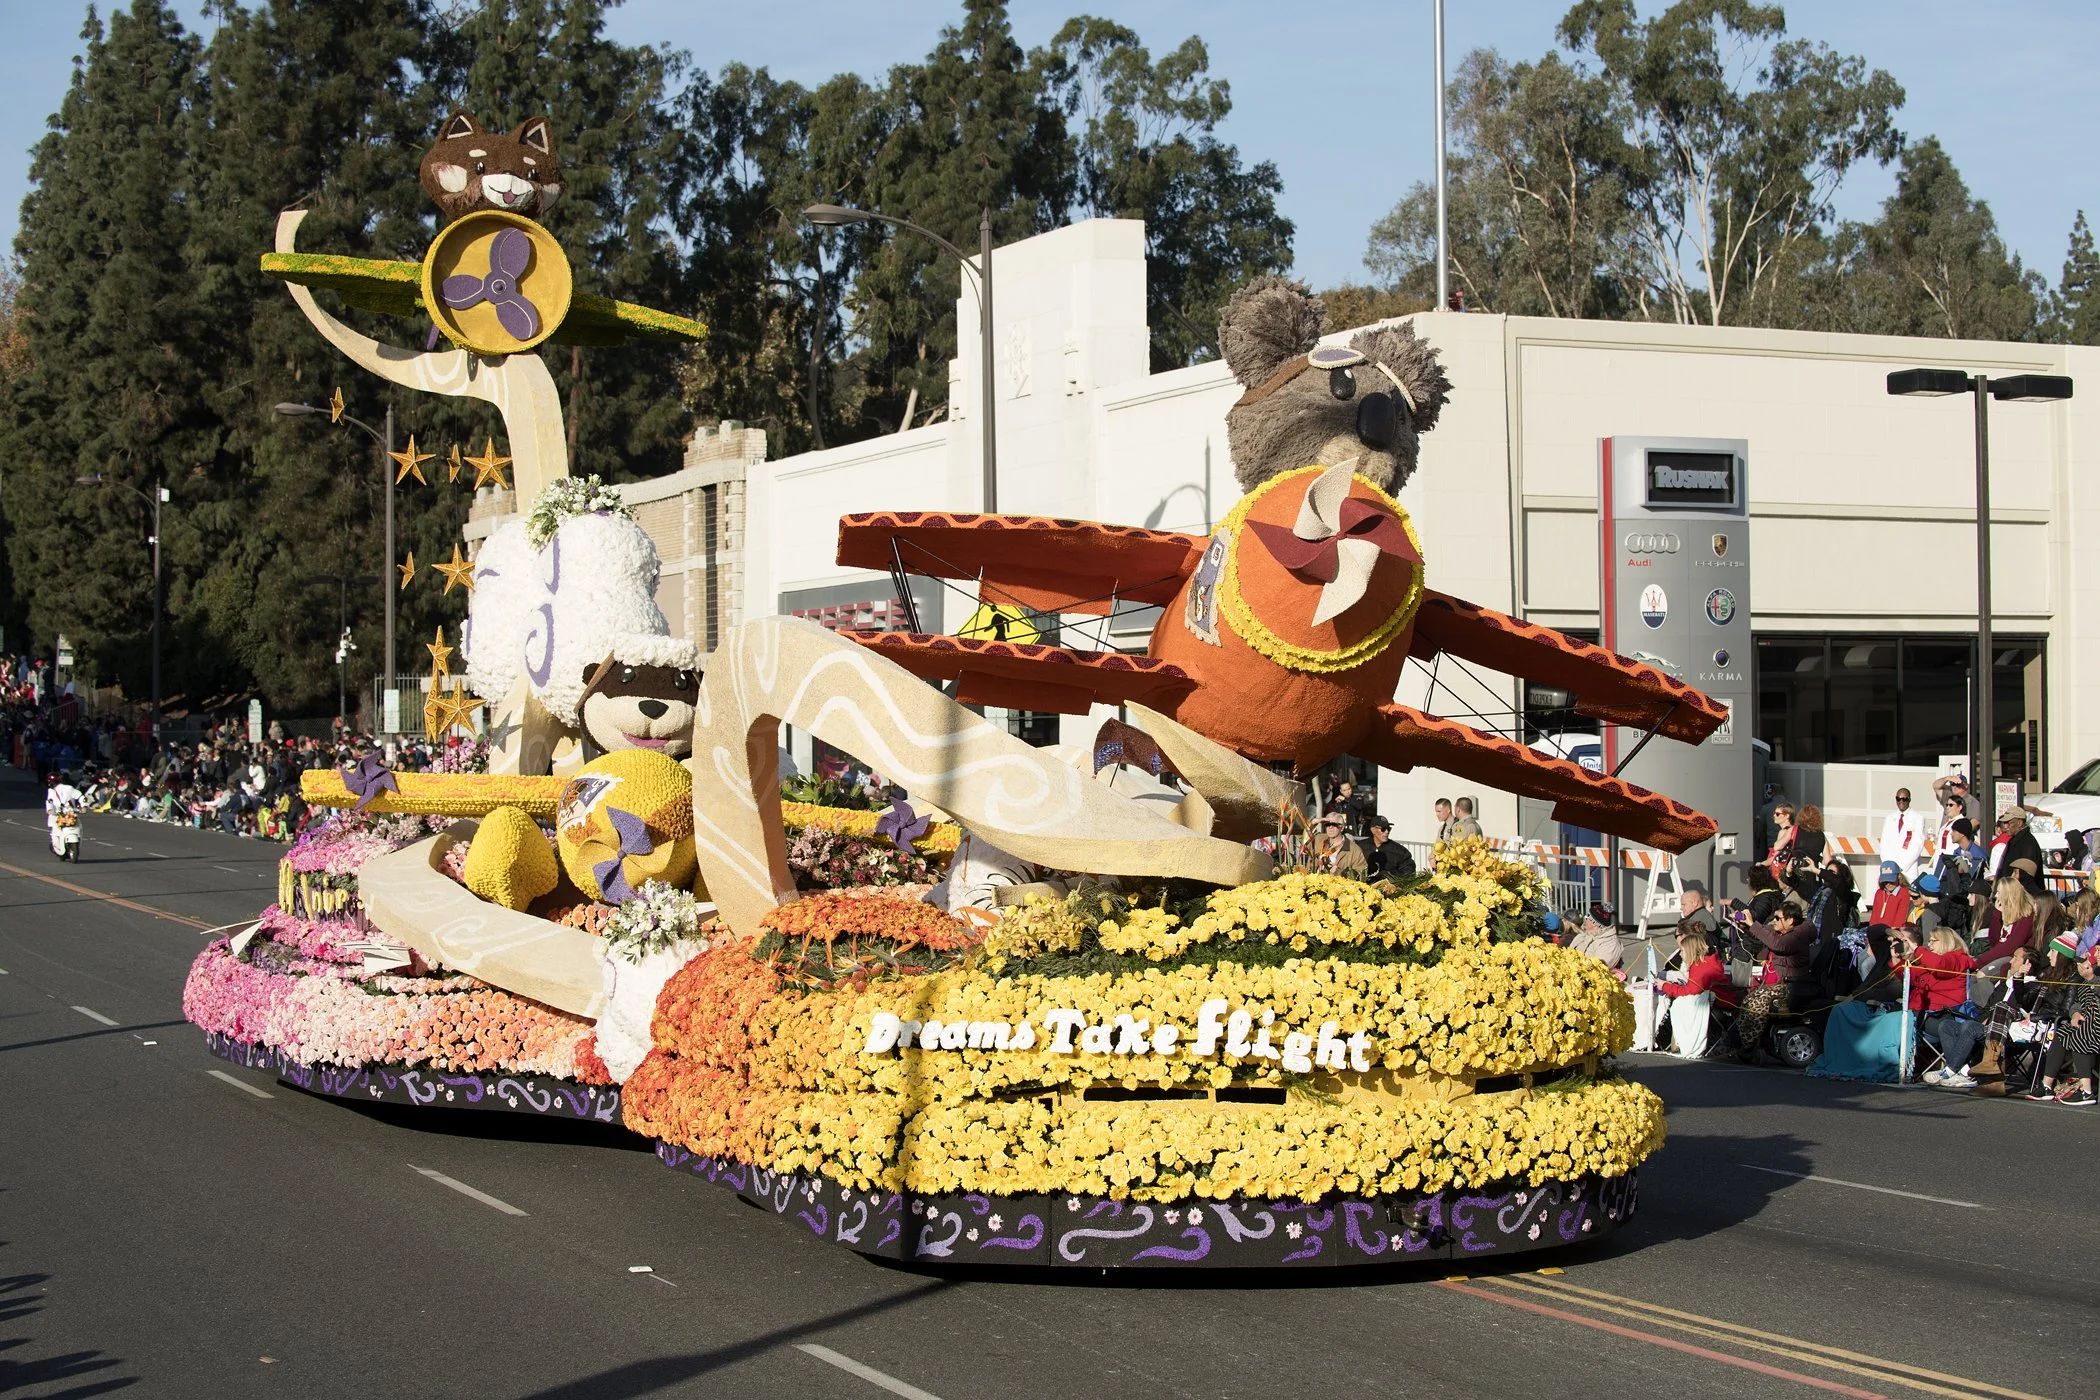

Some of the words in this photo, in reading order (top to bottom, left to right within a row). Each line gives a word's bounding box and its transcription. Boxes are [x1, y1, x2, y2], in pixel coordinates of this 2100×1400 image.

[1654, 465, 1729, 489] RUSNAK
[1627, 559, 1652, 567] Audi
[1700, 672, 1743, 681] KARMA
[864, 1012, 1036, 1053] Dreams
[1044, 1009, 1176, 1055] Take
[1192, 998, 1373, 1074] Flight
